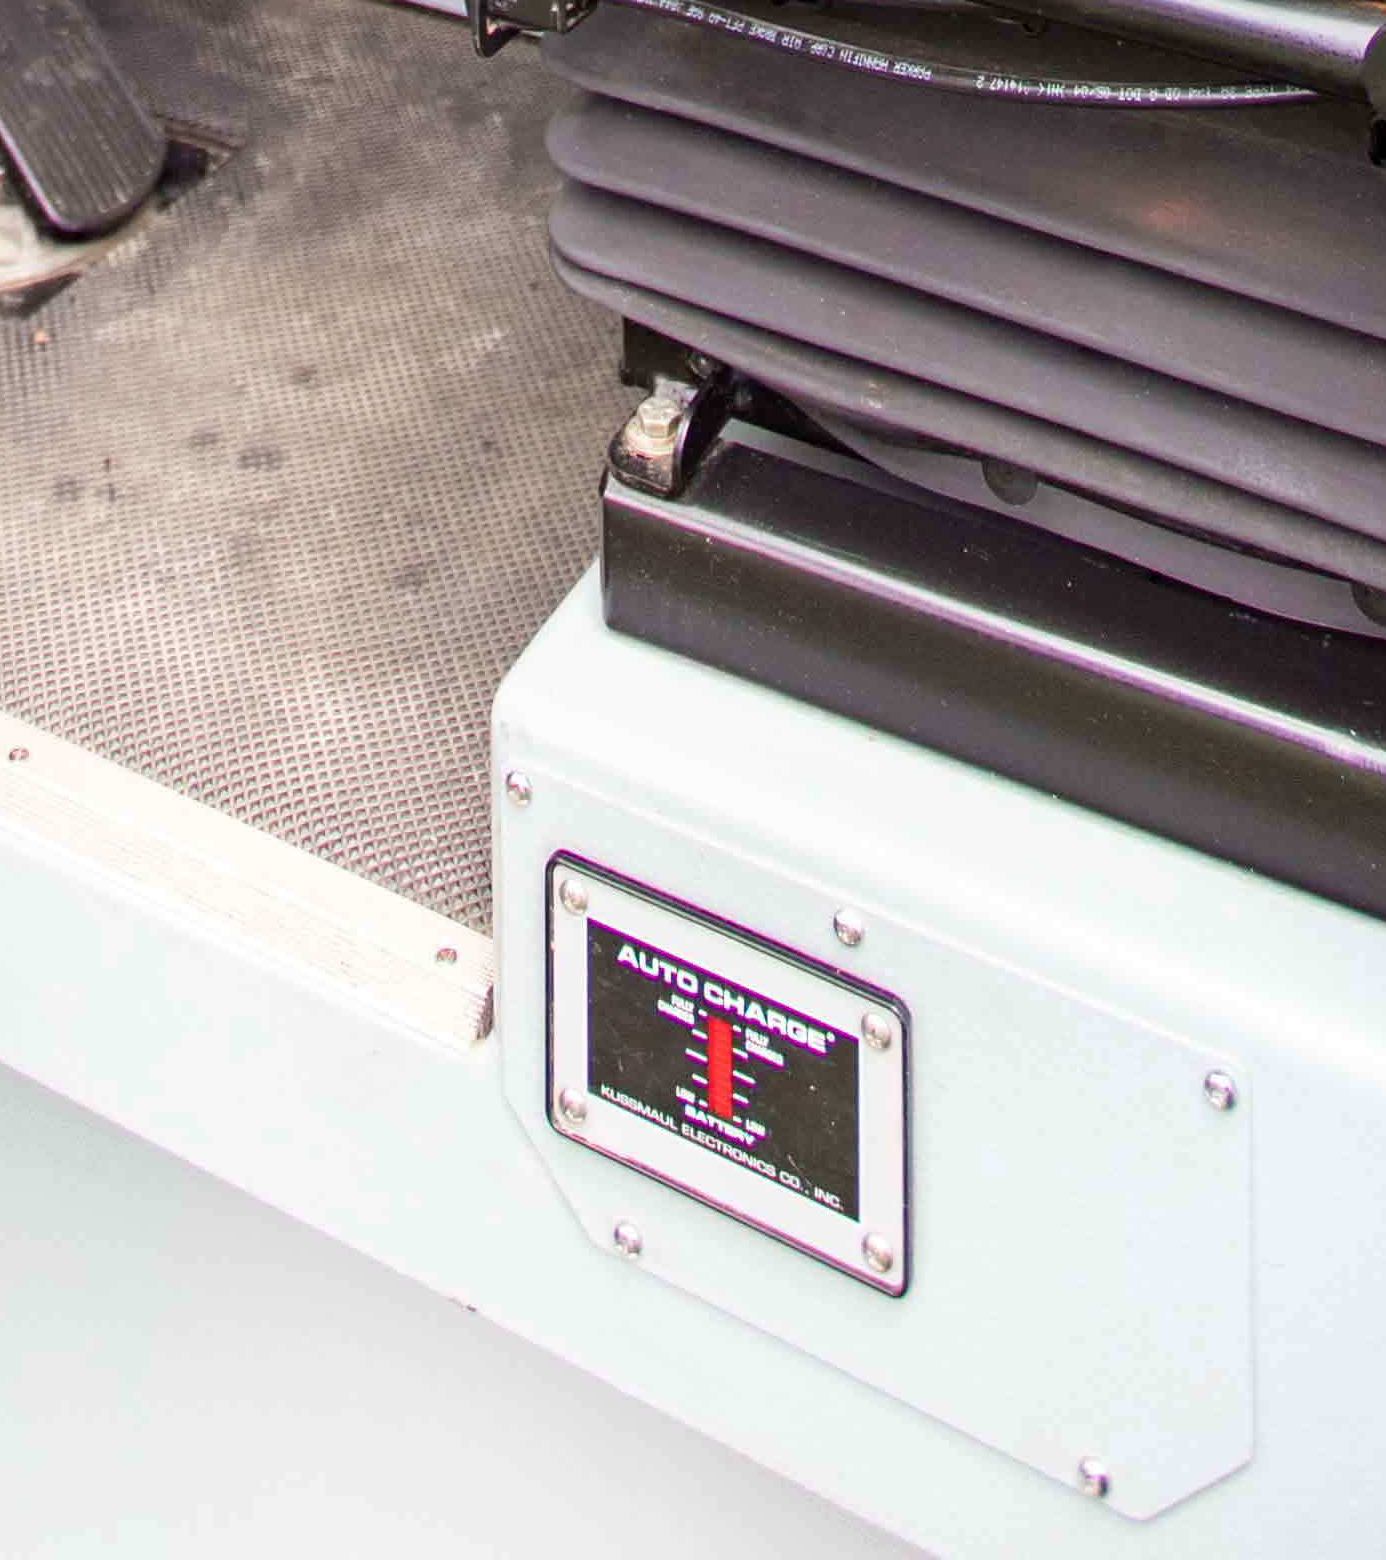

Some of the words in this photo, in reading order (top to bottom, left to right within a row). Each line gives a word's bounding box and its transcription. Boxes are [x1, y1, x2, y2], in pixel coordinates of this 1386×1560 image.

[893, 61, 933, 81] PARKER
[1117, 86, 1142, 103] DOT
[617, 945, 699, 996] AUTO
[703, 981, 828, 1054] CHARGE
[684, 1103, 756, 1145] BATTERY
[601, 1083, 679, 1131] KUSSMAUL
[681, 1122, 777, 1177] ELECTRONICS
[814, 1186, 845, 1211] INC.
